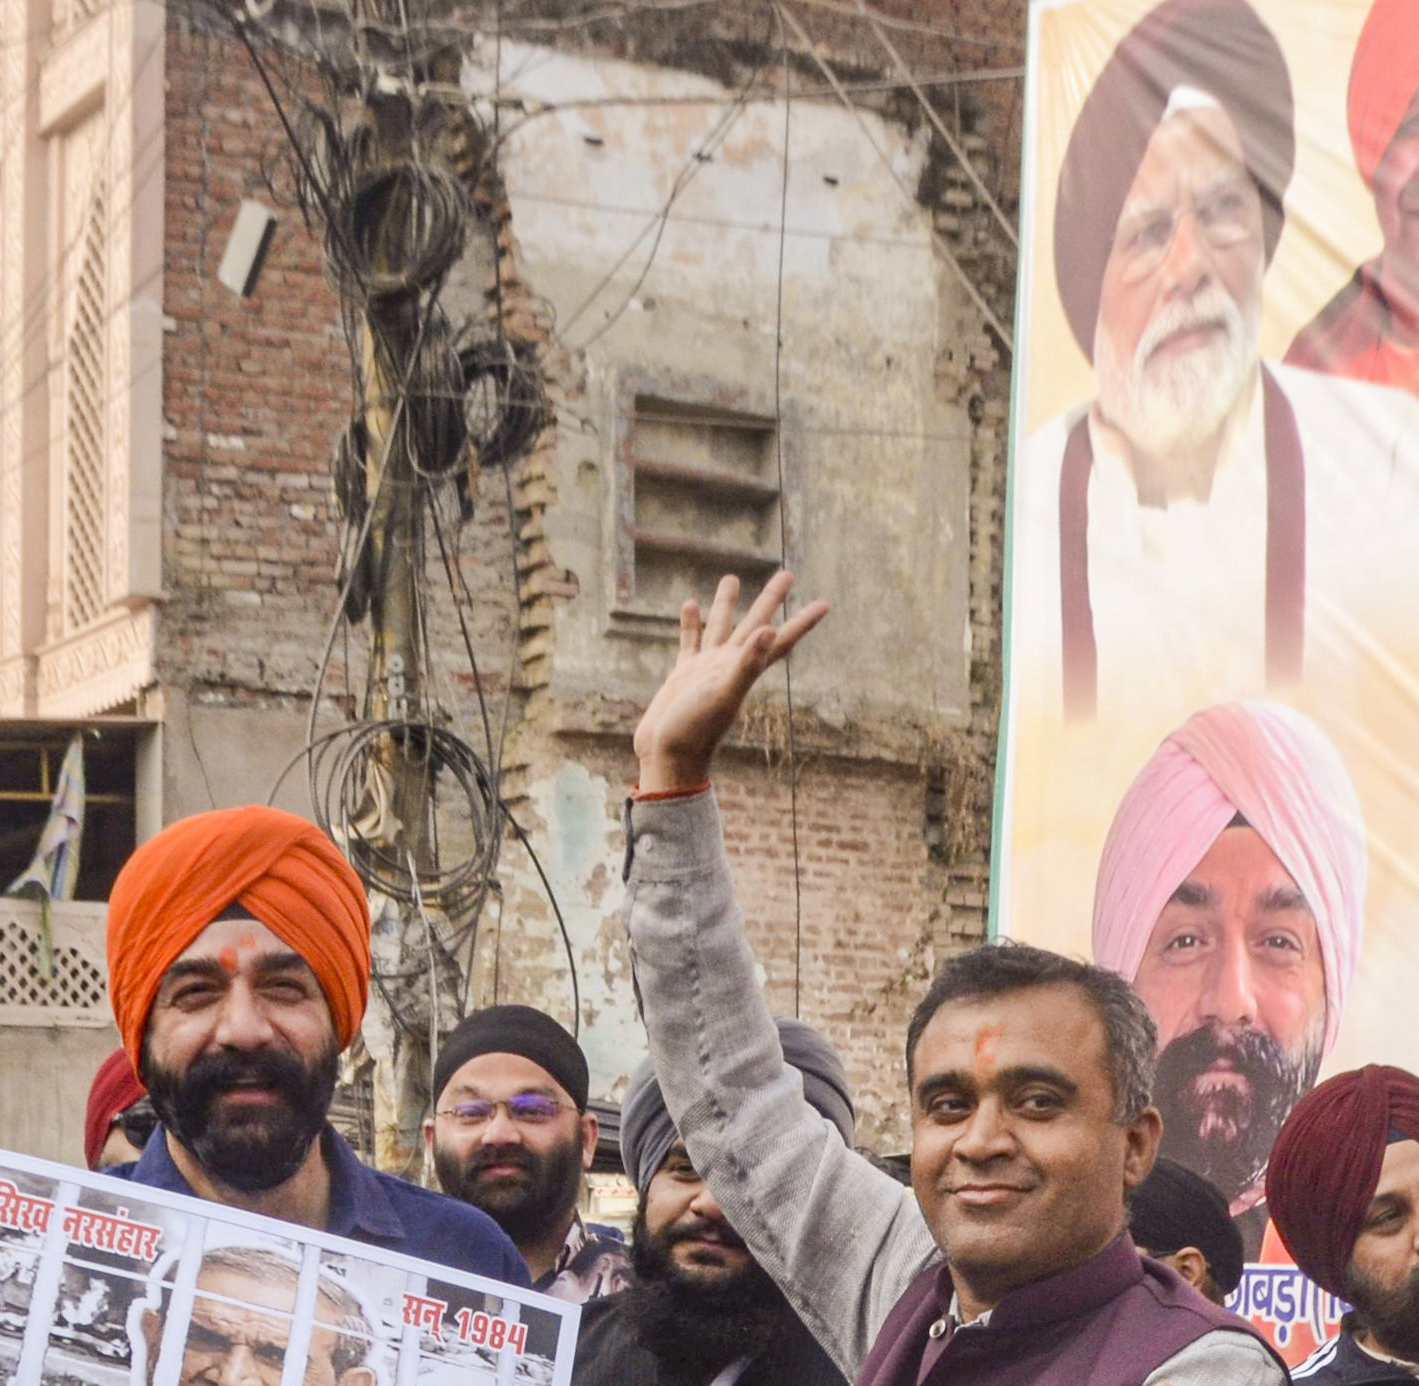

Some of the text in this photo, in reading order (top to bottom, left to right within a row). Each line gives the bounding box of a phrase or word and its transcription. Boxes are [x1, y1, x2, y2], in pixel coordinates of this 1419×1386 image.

[62, 1207, 162, 1260] नरसंहार
[402, 1294, 527, 1356] सन् 1984
